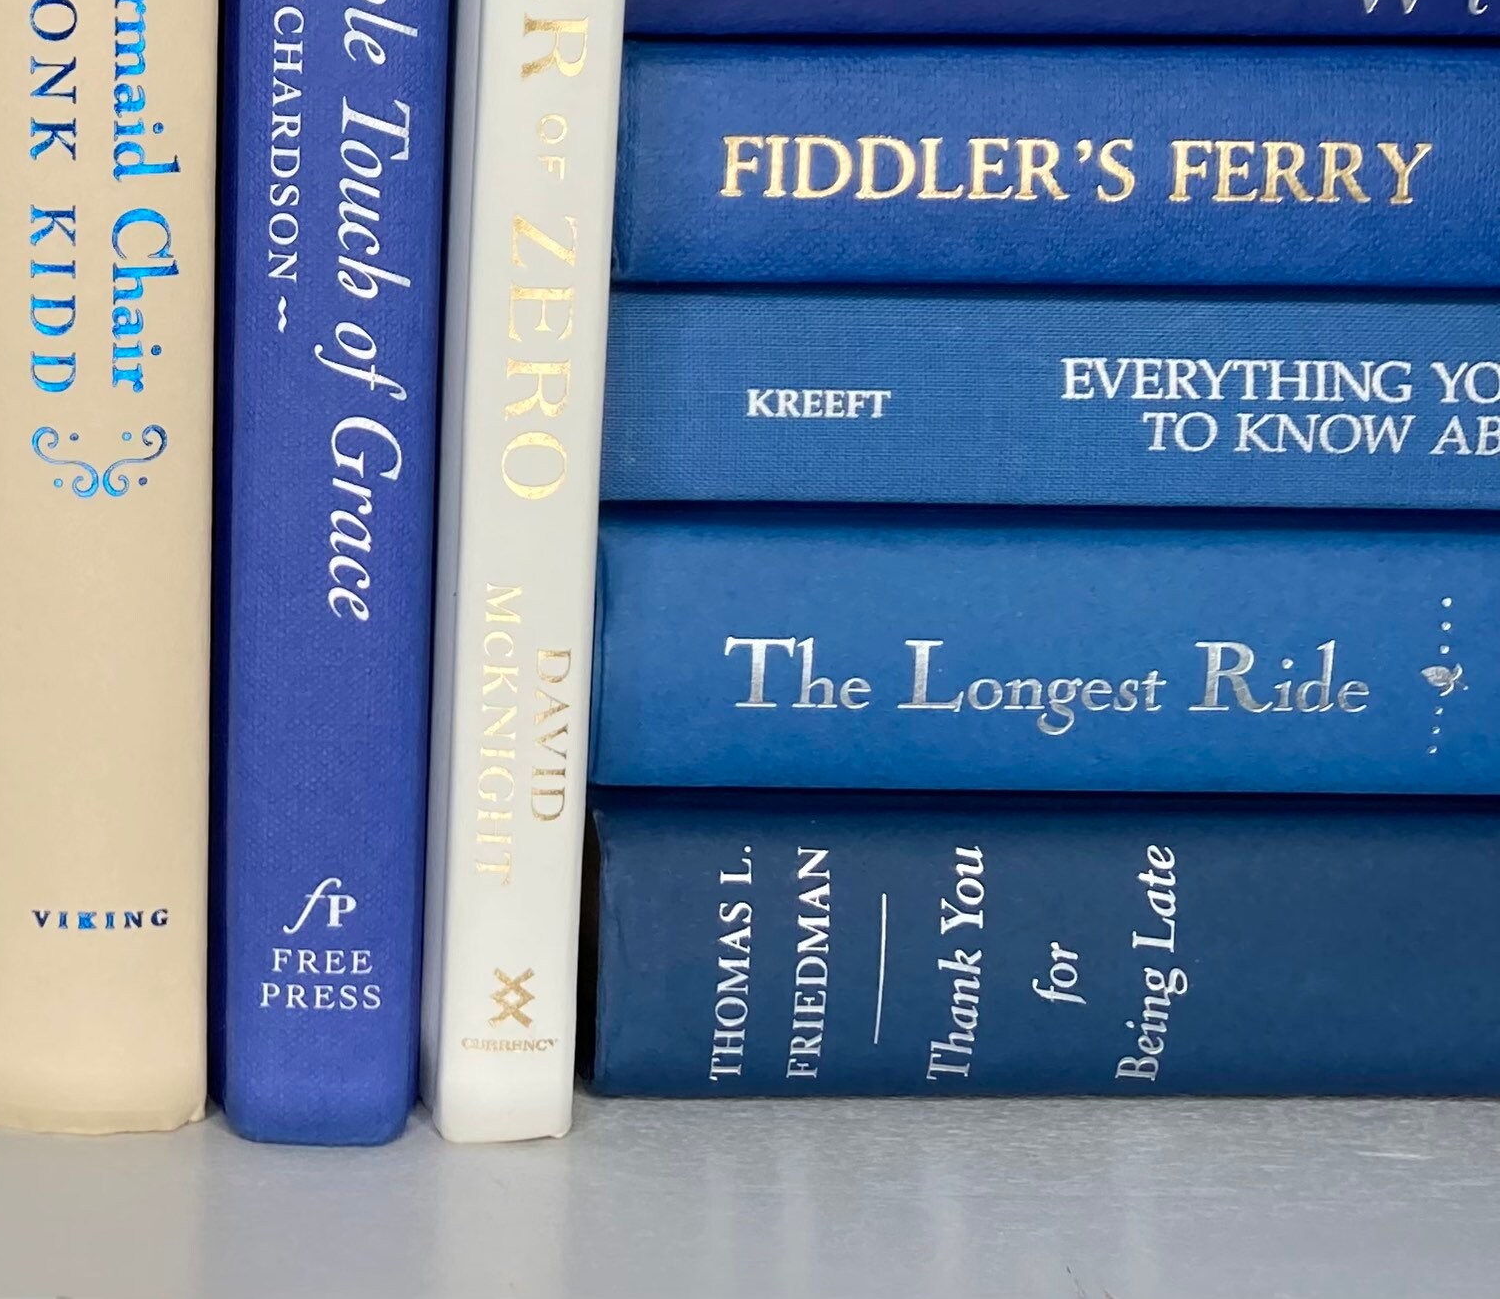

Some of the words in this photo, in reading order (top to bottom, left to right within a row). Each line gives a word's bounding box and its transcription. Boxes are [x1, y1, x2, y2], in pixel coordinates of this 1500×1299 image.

[536, 113, 568, 181] OF
[719, 134, 1136, 203] FIDDLER'S
[1167, 138, 1433, 206] FERRY
[337, 95, 411, 300] Touch
[29, 204, 77, 393] KIDD
[110, 207, 180, 394] Chair
[314, 321, 408, 401] of
[501, 213, 579, 501] ZERO
[1060, 356, 1414, 405] EVERYTHING
[1430, 361, 1500, 405] YO
[746, 387, 891, 420] KREEFT
[1142, 410, 1219, 454] TO
[1233, 413, 1417, 456] KNOW
[327, 415, 403, 622] Grace
[723, 635, 872, 711] The
[896, 637, 1168, 736] Longest
[1188, 637, 1370, 714] Ride
[530, 647, 573, 823] DAVID
[719, 844, 754, 886] L.
[939, 844, 986, 936] You
[1131, 842, 1177, 954] Late
[31, 907, 170, 930] VIKING
[271, 947, 374, 975] FREE
[785, 846, 832, 1080] FRIEDMAN
[259, 981, 383, 1011] PRESS
[708, 901, 754, 1082] THOMAS
[925, 946, 983, 1082] Thank
[1030, 940, 1087, 1005] for
[461, 1037, 558, 1054] CURRENCY
[1114, 966, 1190, 1083] Being
